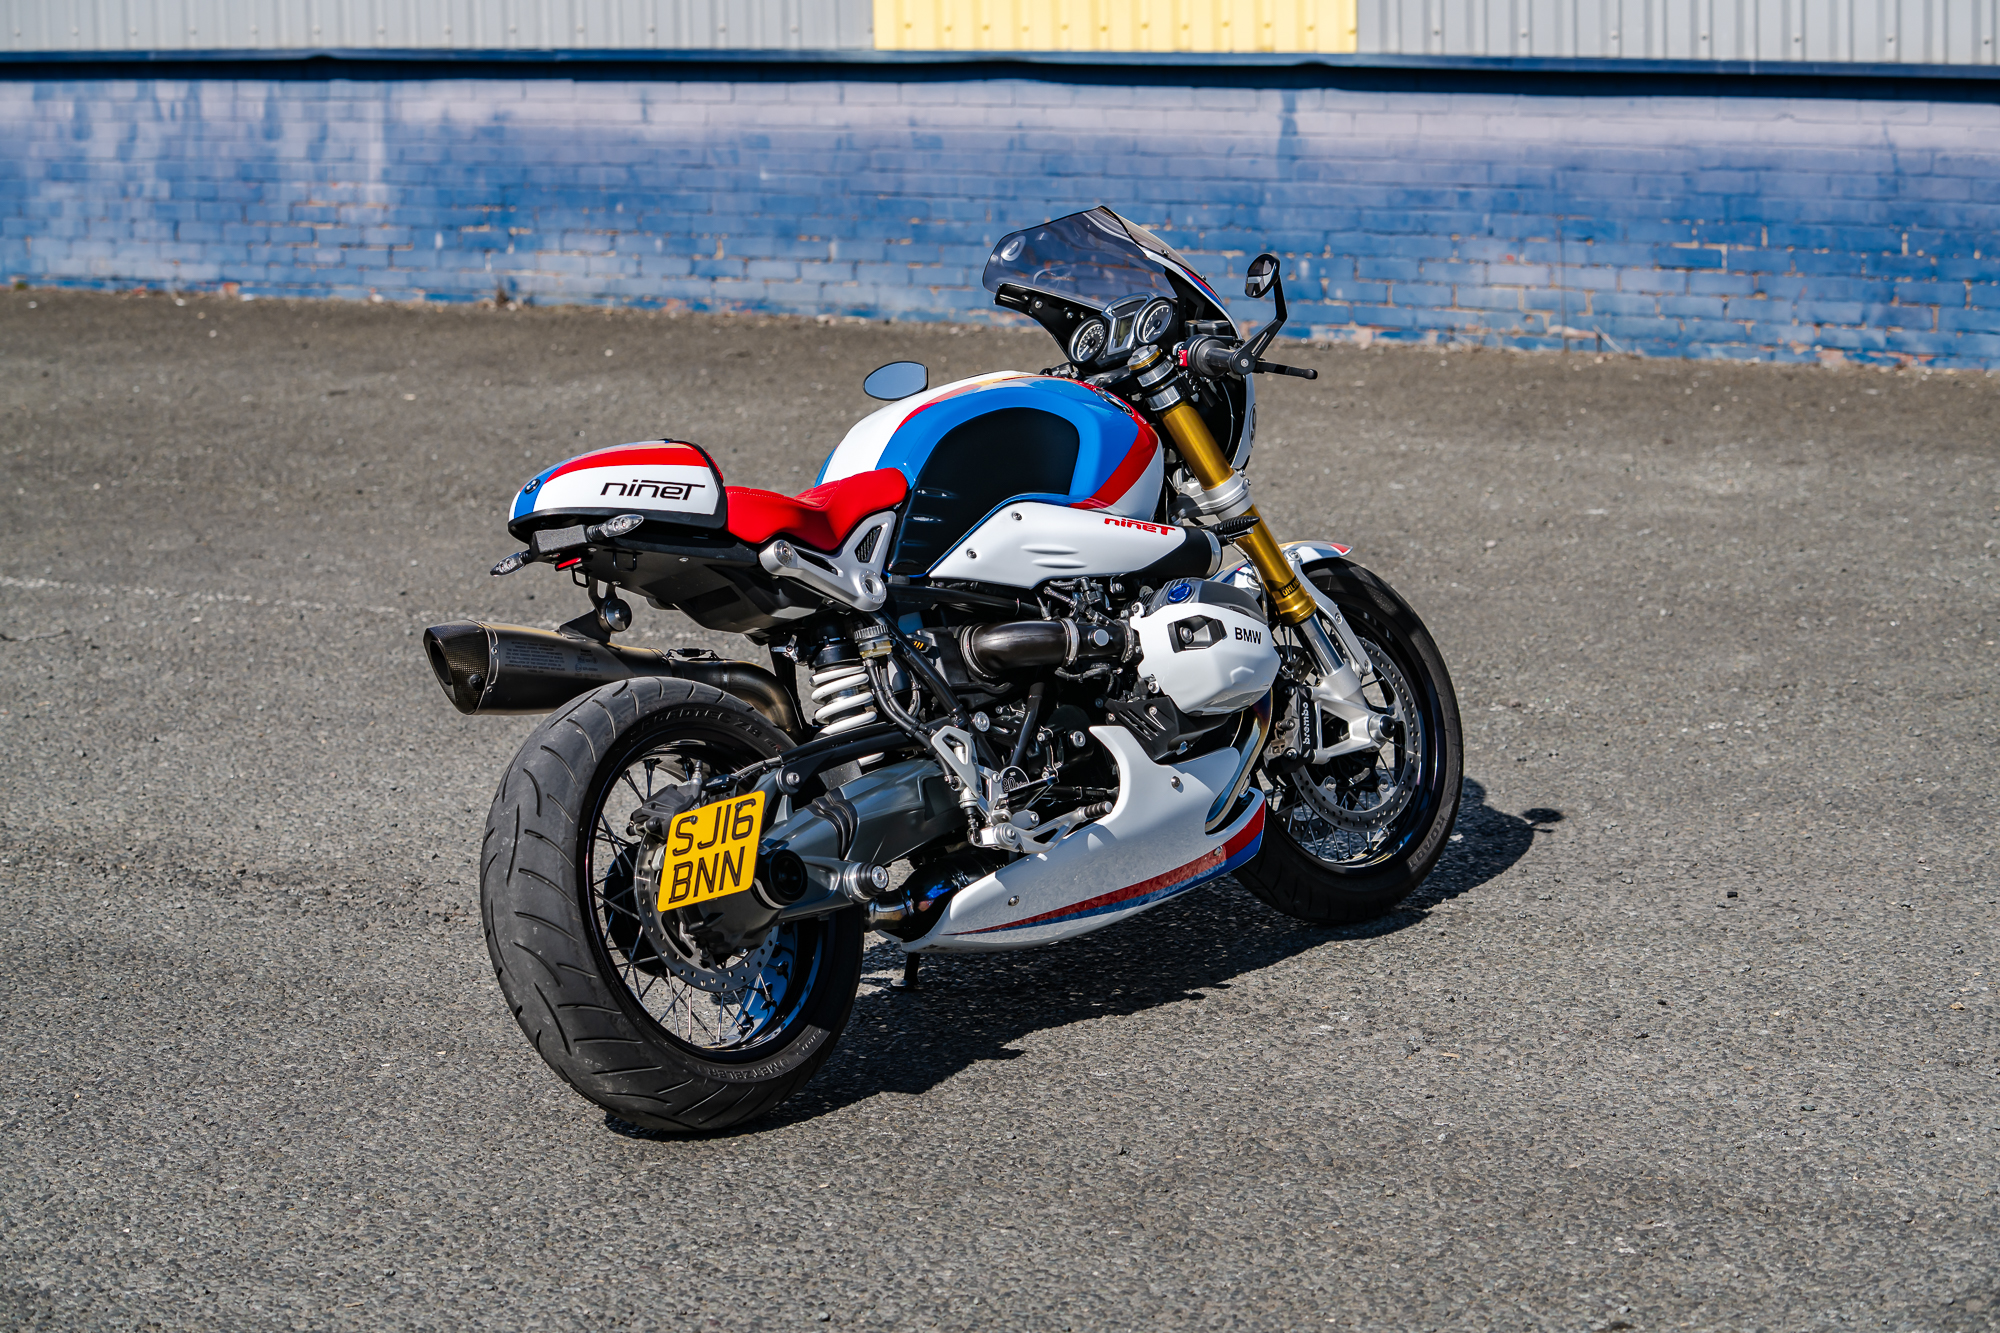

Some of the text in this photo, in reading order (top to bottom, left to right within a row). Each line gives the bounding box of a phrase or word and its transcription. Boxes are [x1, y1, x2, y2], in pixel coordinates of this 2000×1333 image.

[1235, 627, 1262, 644] BMW
[1301, 701, 1311, 745] brembo
[672, 798, 756, 857] SJ16
[668, 845, 746, 904] BNN
[708, 1062, 778, 1080] METZELER
